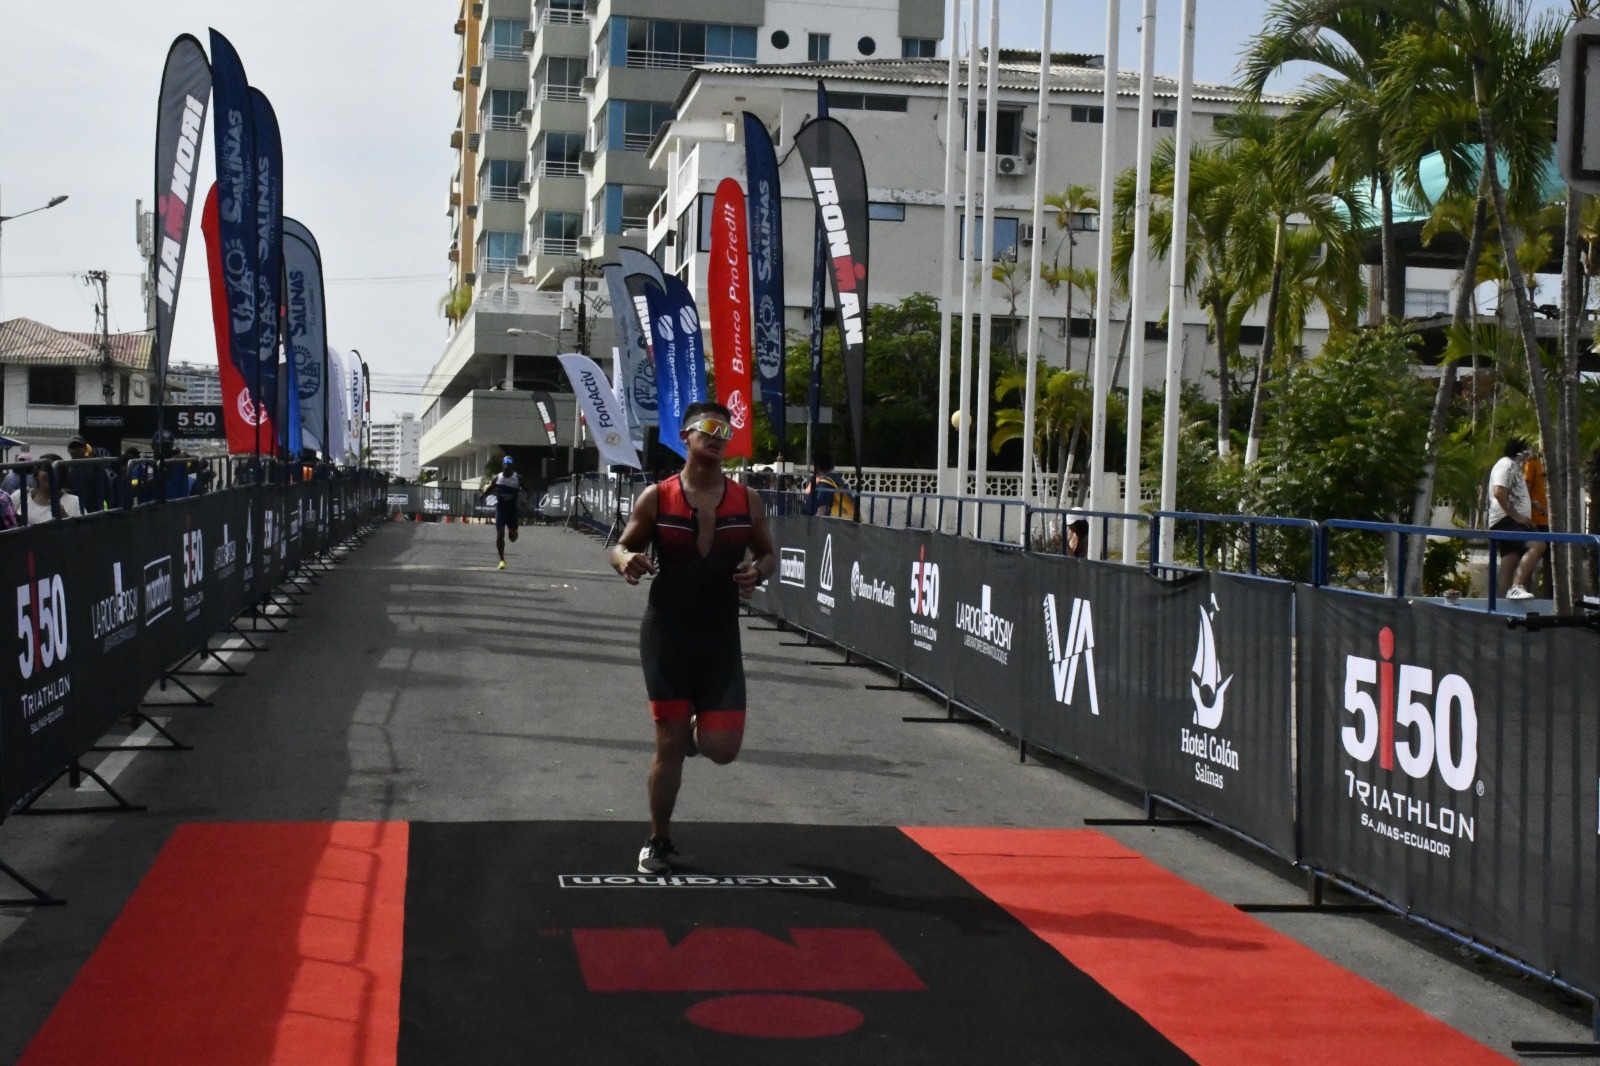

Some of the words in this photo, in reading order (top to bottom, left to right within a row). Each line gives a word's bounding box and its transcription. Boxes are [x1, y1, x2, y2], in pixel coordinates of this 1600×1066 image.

[221, 108, 243, 224] SALINAS
[724, 202, 740, 304] ProCredit
[757, 179, 773, 284] SALINAS
[810, 166, 867, 346] IRONMAN
[290, 270, 307, 337] SALINAS
[580, 370, 613, 429] FontActiv
[858, 574, 873, 600] Banco
[20, 673, 71, 719] TRIATHLON
[1341, 625, 1479, 792] 5i50
[1181, 727, 1208, 760] Hotel
[1209, 734, 1240, 771] Colón
[1194, 761, 1224, 790] Salinas
[1344, 769, 1476, 842] TRIATHLON
[571, 875, 820, 887] marathon
